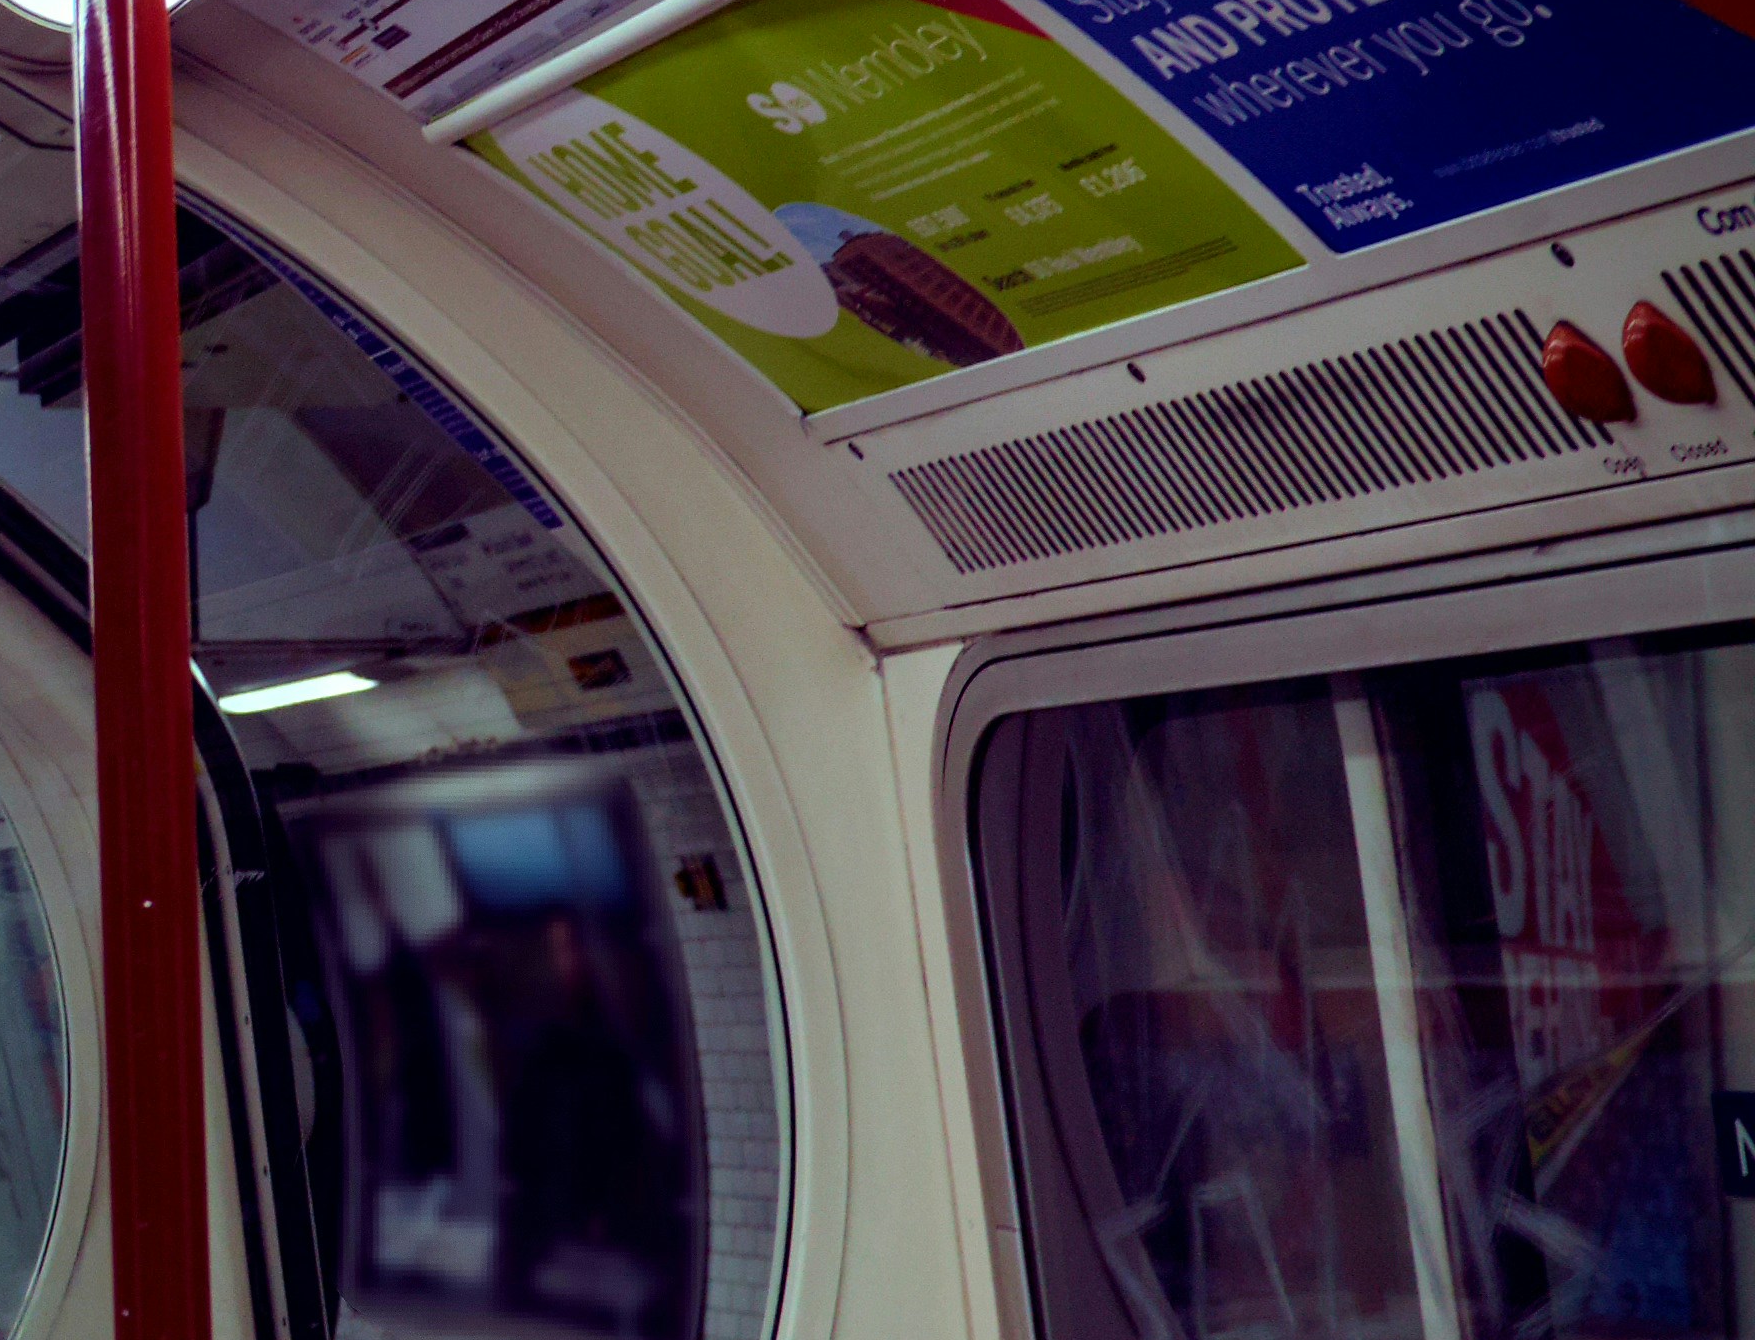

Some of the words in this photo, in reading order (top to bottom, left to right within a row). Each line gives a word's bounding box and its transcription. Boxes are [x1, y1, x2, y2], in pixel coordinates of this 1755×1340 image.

[807, 10, 988, 114] Wembley
[1131, 14, 1239, 80] AND
[1195, 24, 1386, 131] wherever
[1372, 10, 1482, 83] you
[527, 121, 699, 220] HOME
[1294, 161, 1394, 208] Trusted.
[1322, 191, 1415, 231] Always.
[625, 198, 794, 292] GOAL!
